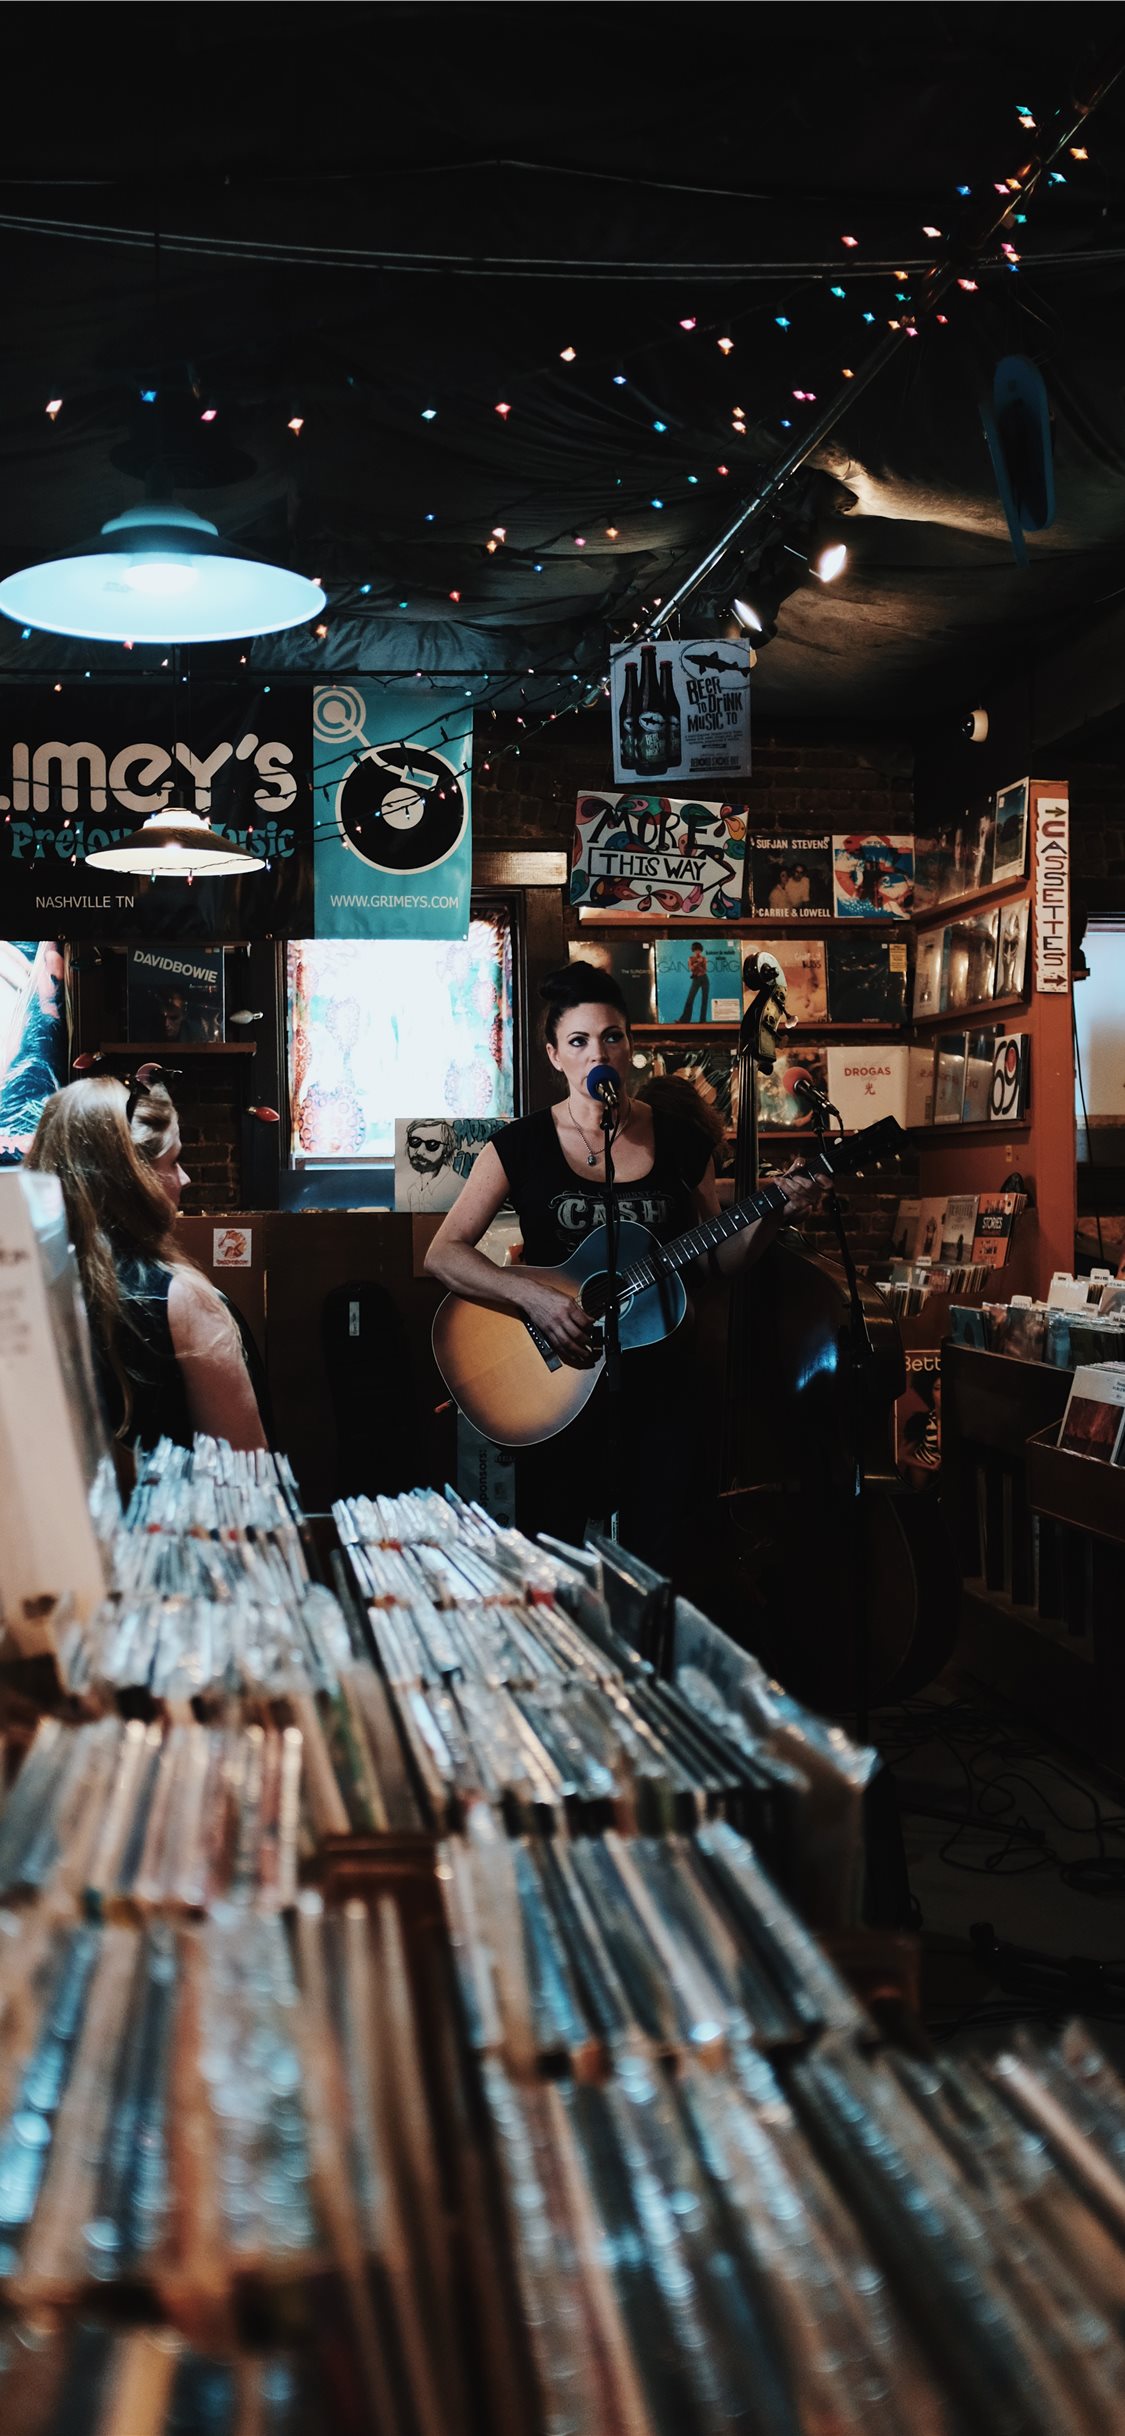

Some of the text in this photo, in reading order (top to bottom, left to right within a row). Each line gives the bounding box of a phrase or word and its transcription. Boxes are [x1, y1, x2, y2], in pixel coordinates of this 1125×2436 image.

[587, 806, 722, 859] MORE
[756, 837, 829, 850] SUFJAN STEVENS
[599, 853, 706, 881] THIS WAY
[1041, 820, 1068, 966] CASSETTES
[35, 896, 135, 909] NASHVILLE TN
[330, 895, 459, 909] WWW.GRIMEYS.COM
[758, 907, 831, 918] CARRIE & LOWELL
[844, 1067, 892, 1077] DROGAS
[992, 1039, 1020, 1116] 69
[864, 1082, 876, 1096] 光
